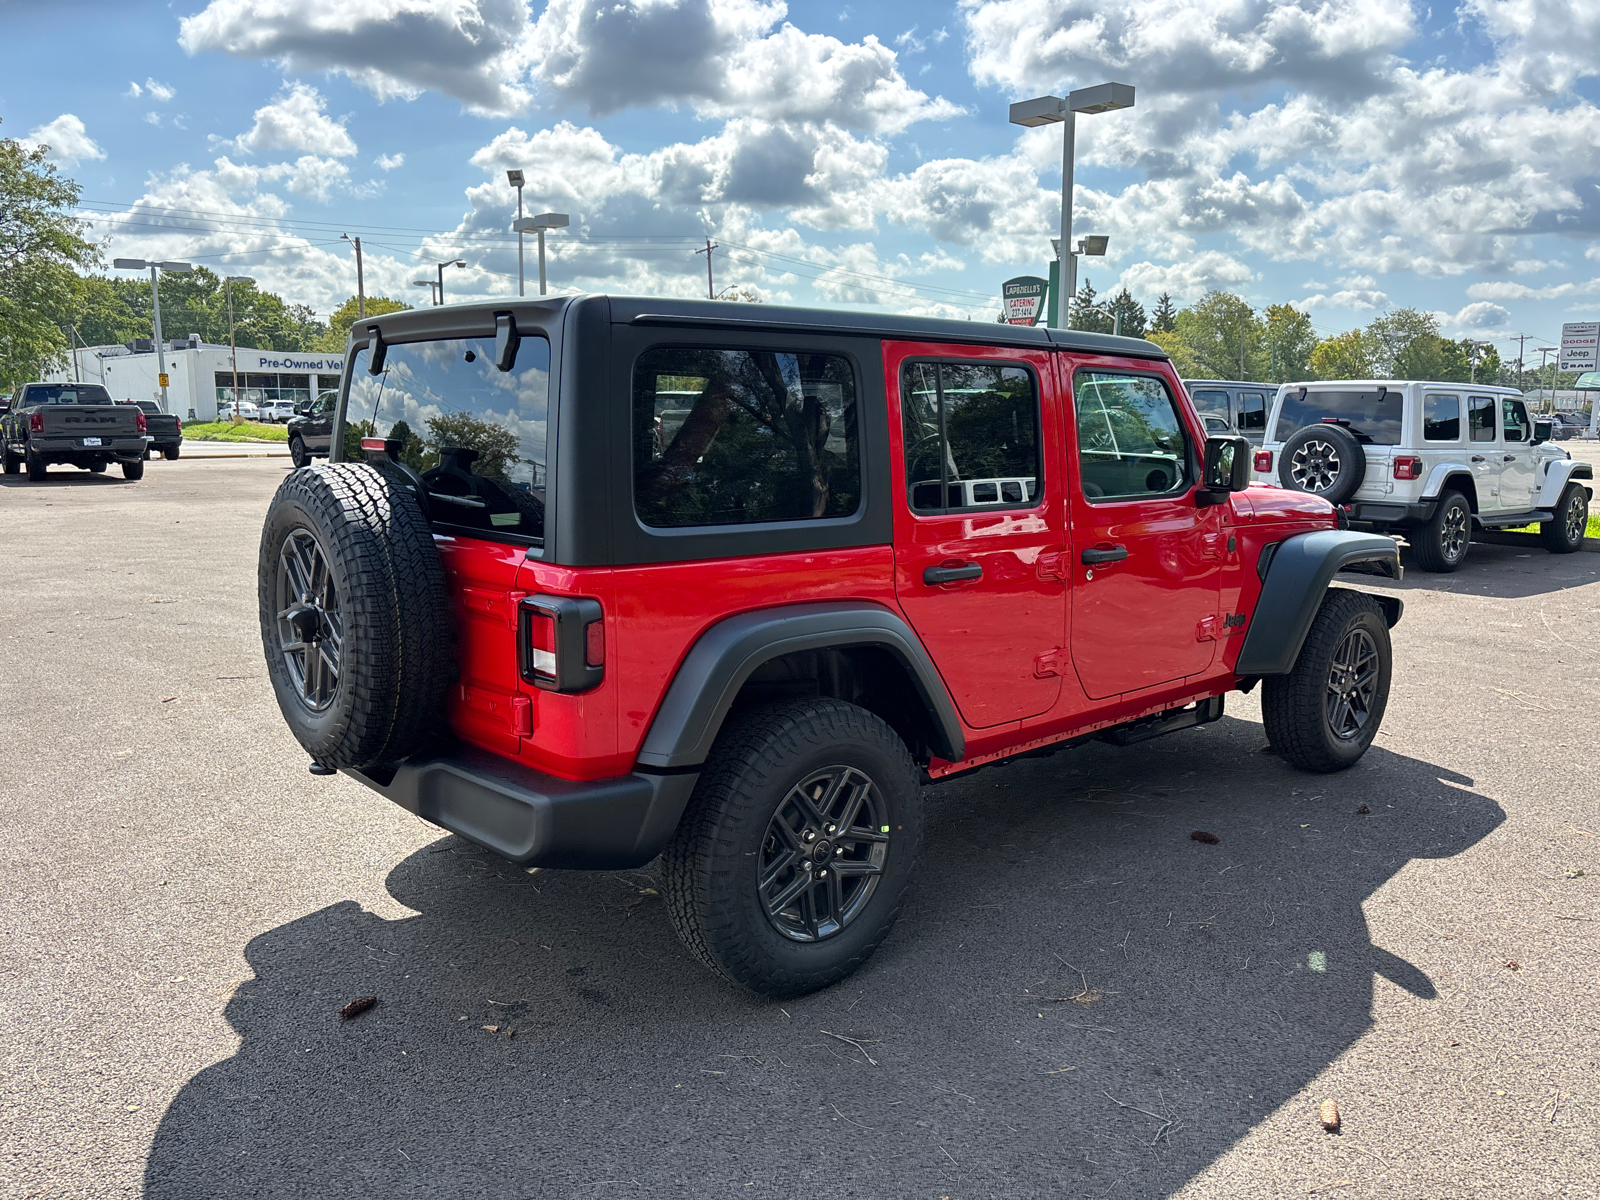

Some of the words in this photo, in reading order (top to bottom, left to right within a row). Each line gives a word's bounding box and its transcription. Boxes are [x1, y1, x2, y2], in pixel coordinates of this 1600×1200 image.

[1010, 298, 1034, 308] CATERING
[1011, 309, 1032, 317] 237-1414
[1567, 350, 1589, 358] Jeep
[259, 357, 323, 369] Pre-Owned
[64, 416, 117, 424] RAM
[1223, 612, 1246, 628] Jeep
